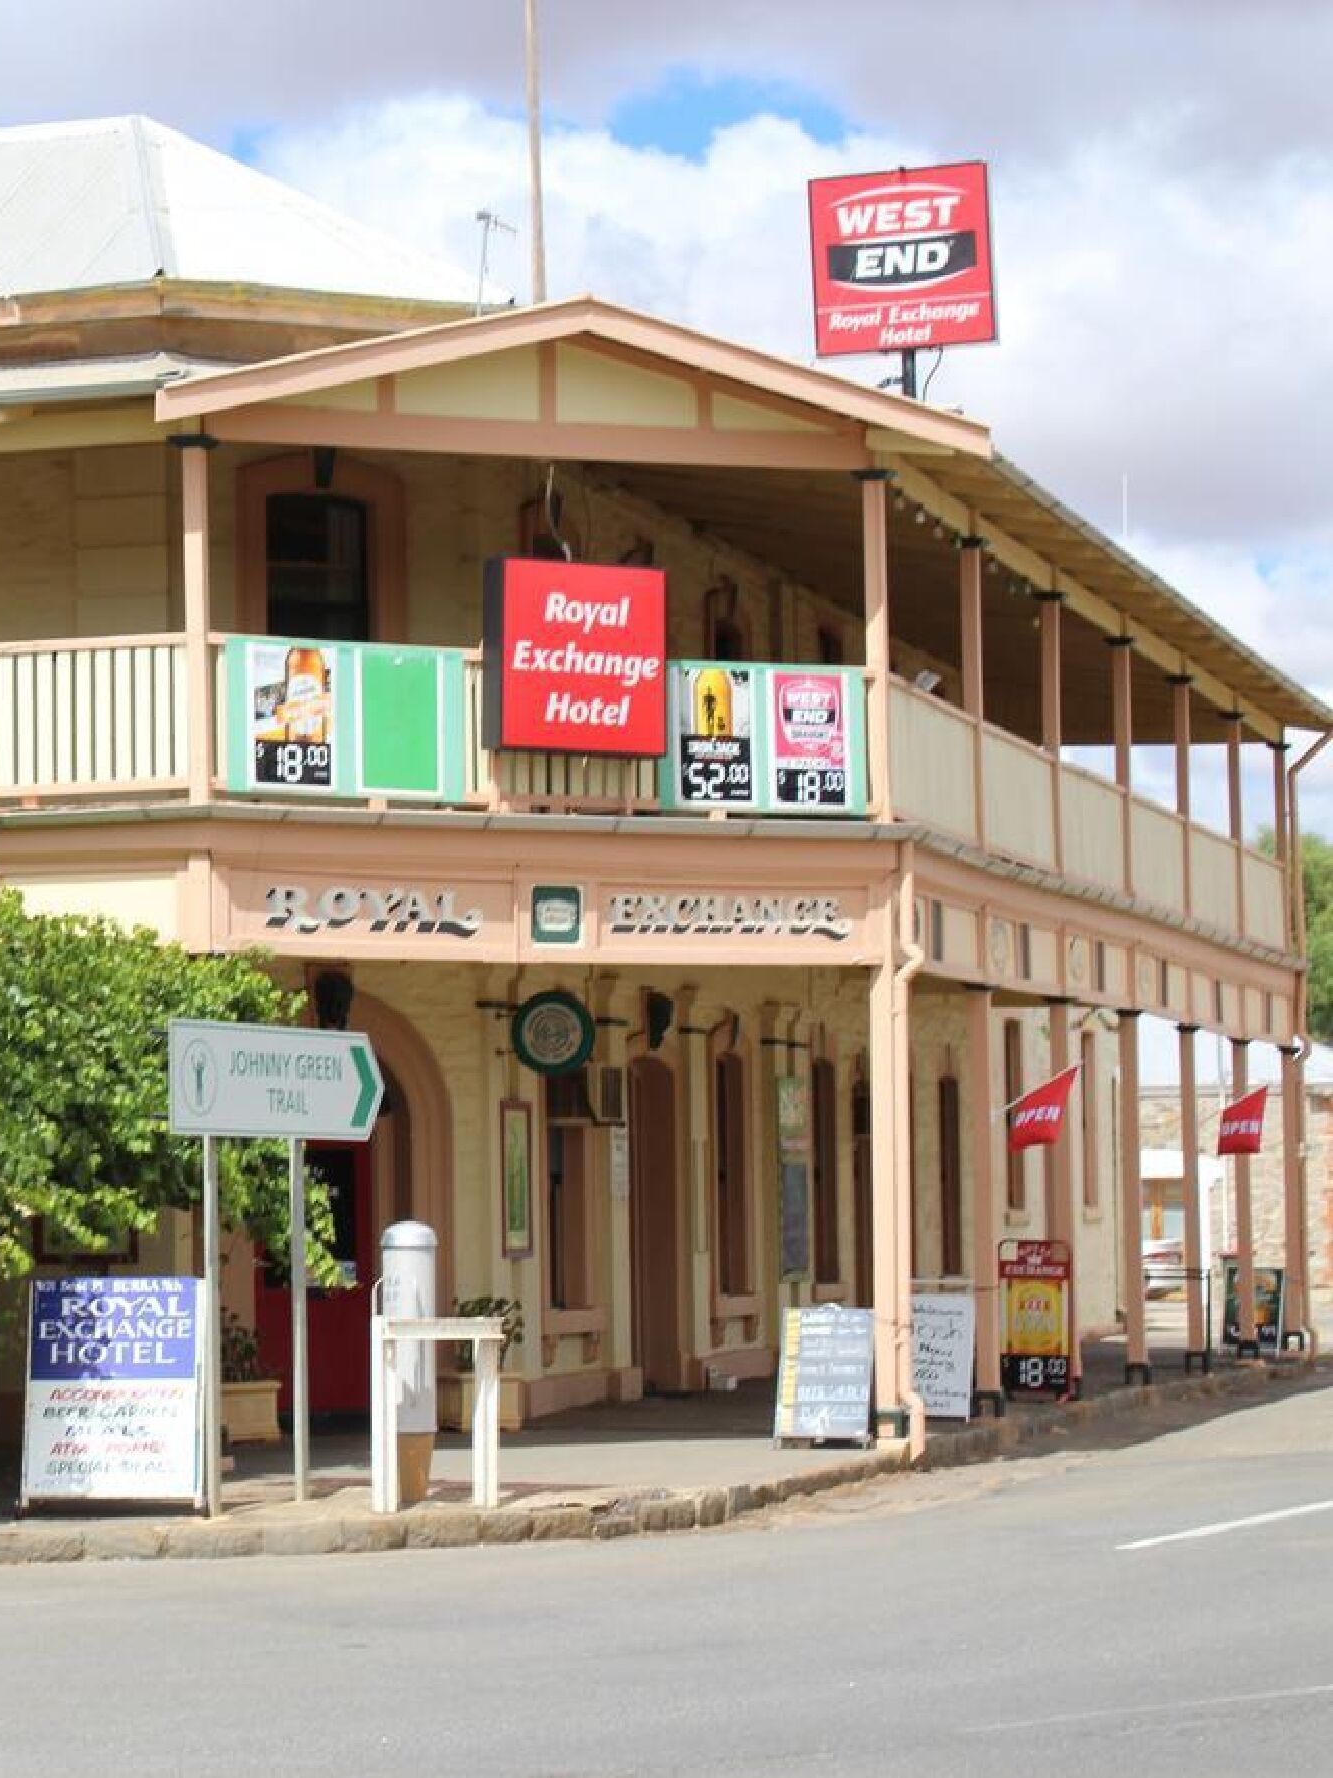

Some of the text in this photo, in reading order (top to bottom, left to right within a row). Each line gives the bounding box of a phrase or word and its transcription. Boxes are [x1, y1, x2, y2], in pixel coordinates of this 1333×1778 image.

[835, 195, 960, 236] WEST
[855, 242, 950, 280] END
[829, 302, 980, 332] Royal Exchange
[879, 323, 931, 345] Hotel
[544, 591, 631, 634] Royal
[512, 639, 659, 686] Exchange
[544, 691, 631, 726] Hotel
[266, 886, 482, 938] ROYAL
[610, 894, 852, 941] EXCHANGE
[229, 1050, 342, 1081] JOHNNY GREEN
[267, 1087, 310, 1115] TRAIL
[1016, 1106, 1060, 1127] OPEN
[1221, 1121, 1259, 1135] OPEN
[62, 1297, 189, 1317] ROYAL
[39, 1319, 192, 1340] EXCHANGE
[50, 1341, 176, 1364] HOTEL
